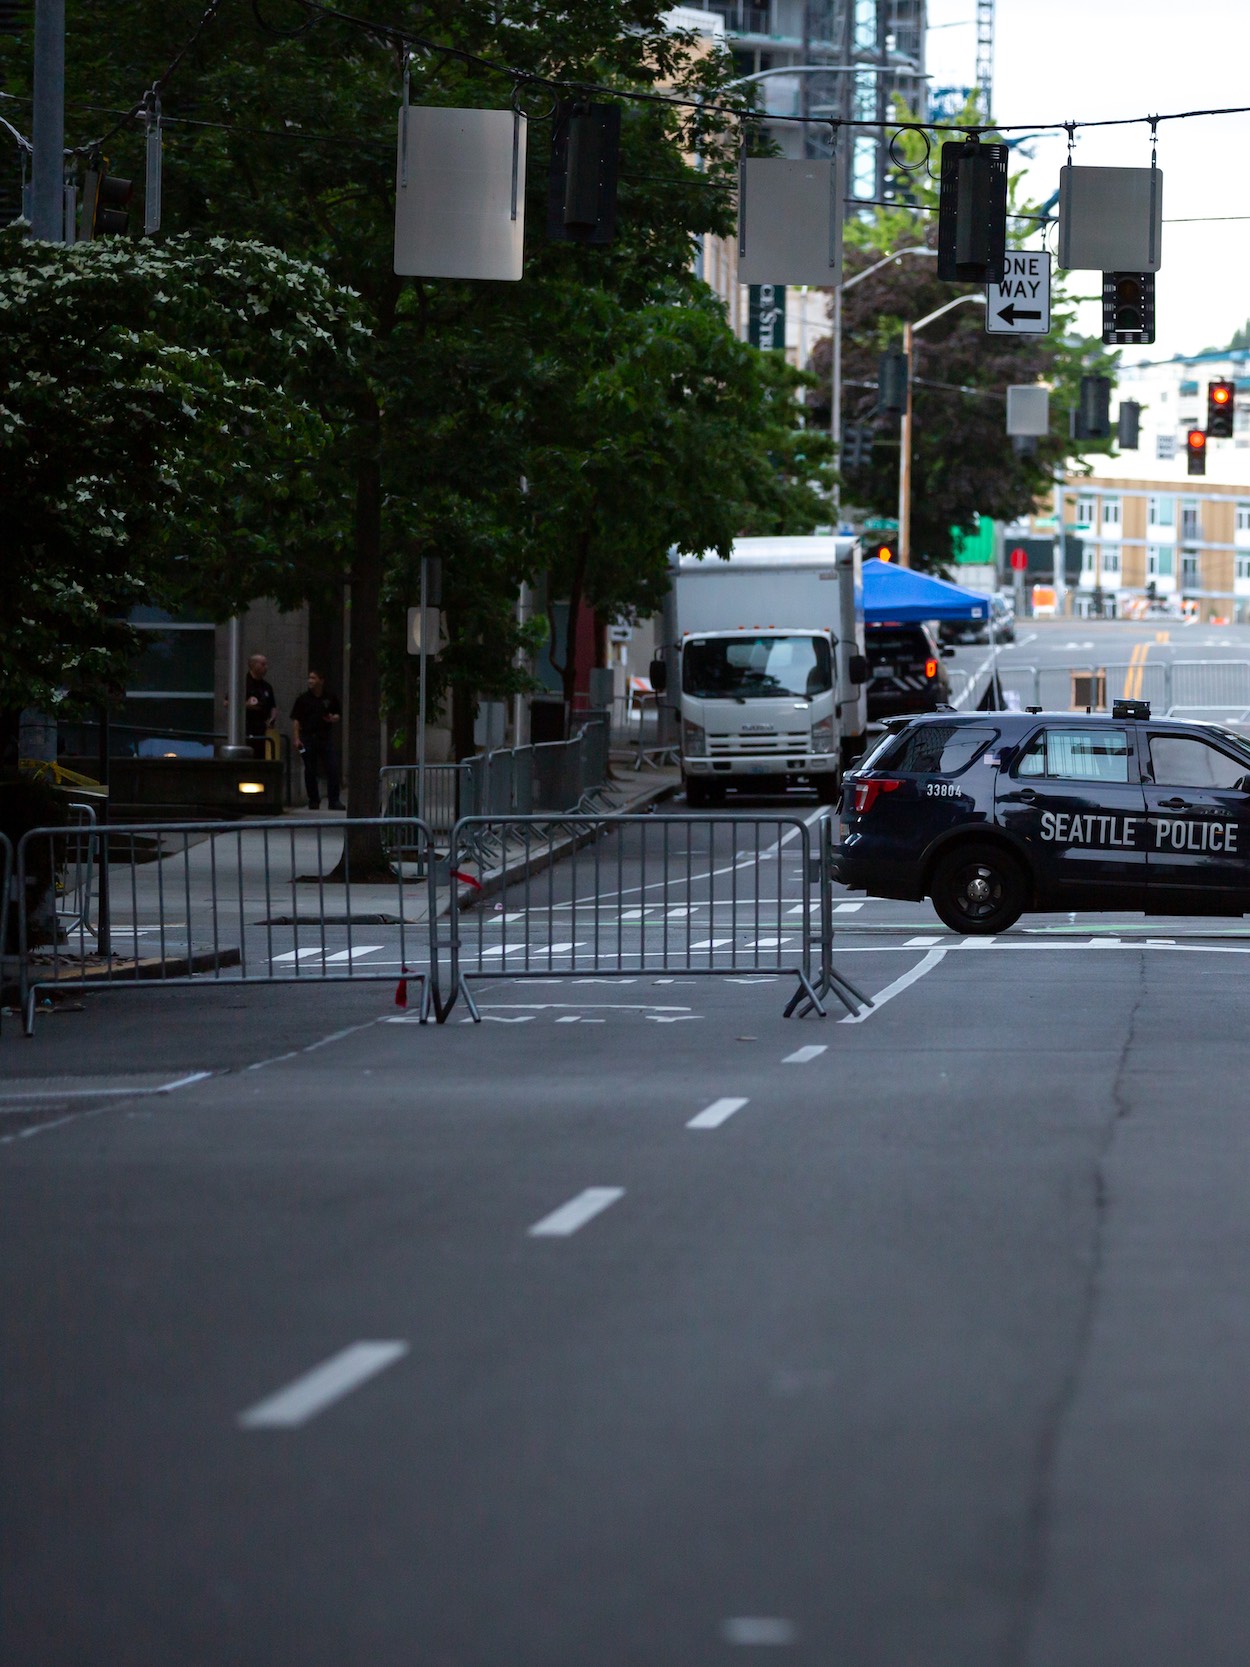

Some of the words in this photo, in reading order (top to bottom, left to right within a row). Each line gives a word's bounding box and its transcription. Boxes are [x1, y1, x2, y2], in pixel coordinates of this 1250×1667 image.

[1004, 258, 1039, 276] ONE
[999, 280, 1040, 298] WAY
[926, 784, 962, 797] 33804
[1040, 812, 1137, 846] SEATTLE
[1155, 819, 1239, 852] POLICE
